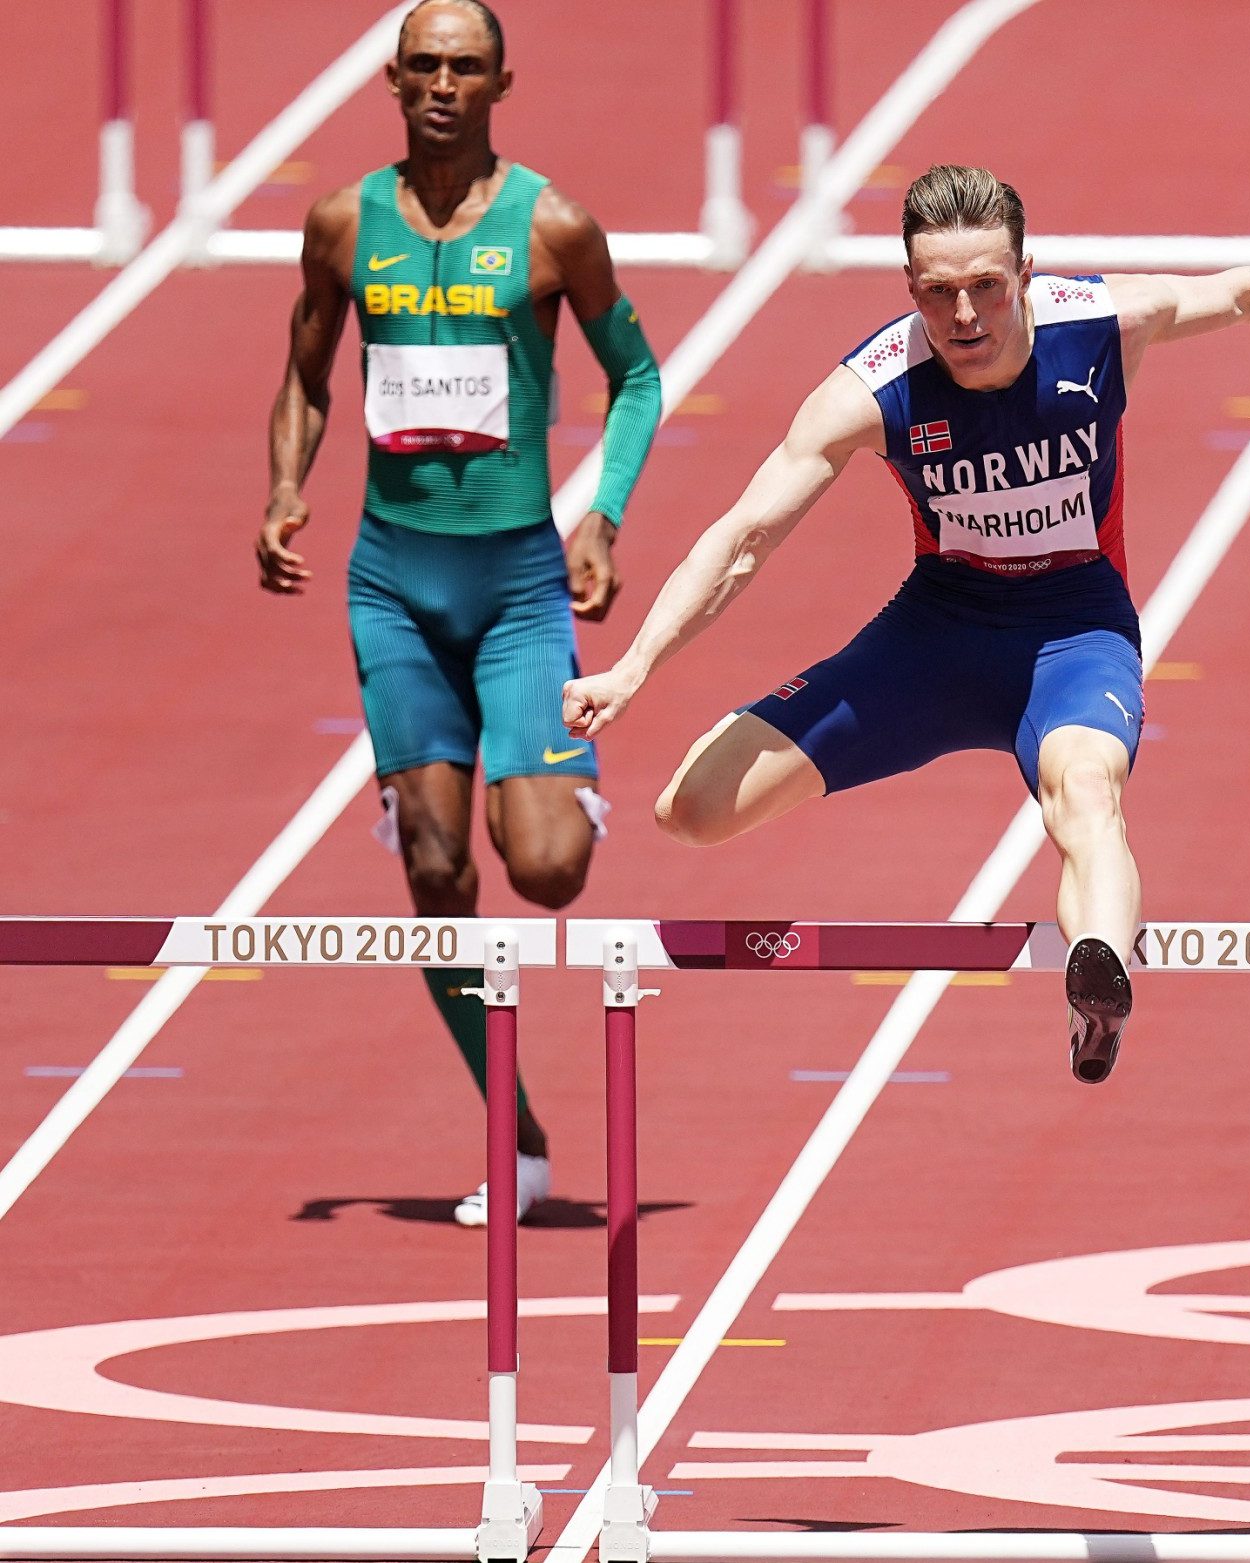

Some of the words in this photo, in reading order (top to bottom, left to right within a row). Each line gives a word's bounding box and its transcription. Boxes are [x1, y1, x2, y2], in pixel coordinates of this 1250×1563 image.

[364, 284, 511, 317] BRASIL
[411, 376, 491, 396] SANTOS
[922, 421, 1099, 495] NORWAY
[983, 561, 1007, 571] TOKYO
[1008, 563, 1027, 571] 2020
[203, 924, 343, 962] TOKYO
[355, 925, 458, 962] 2020
[1128, 928, 1205, 967] KYO
